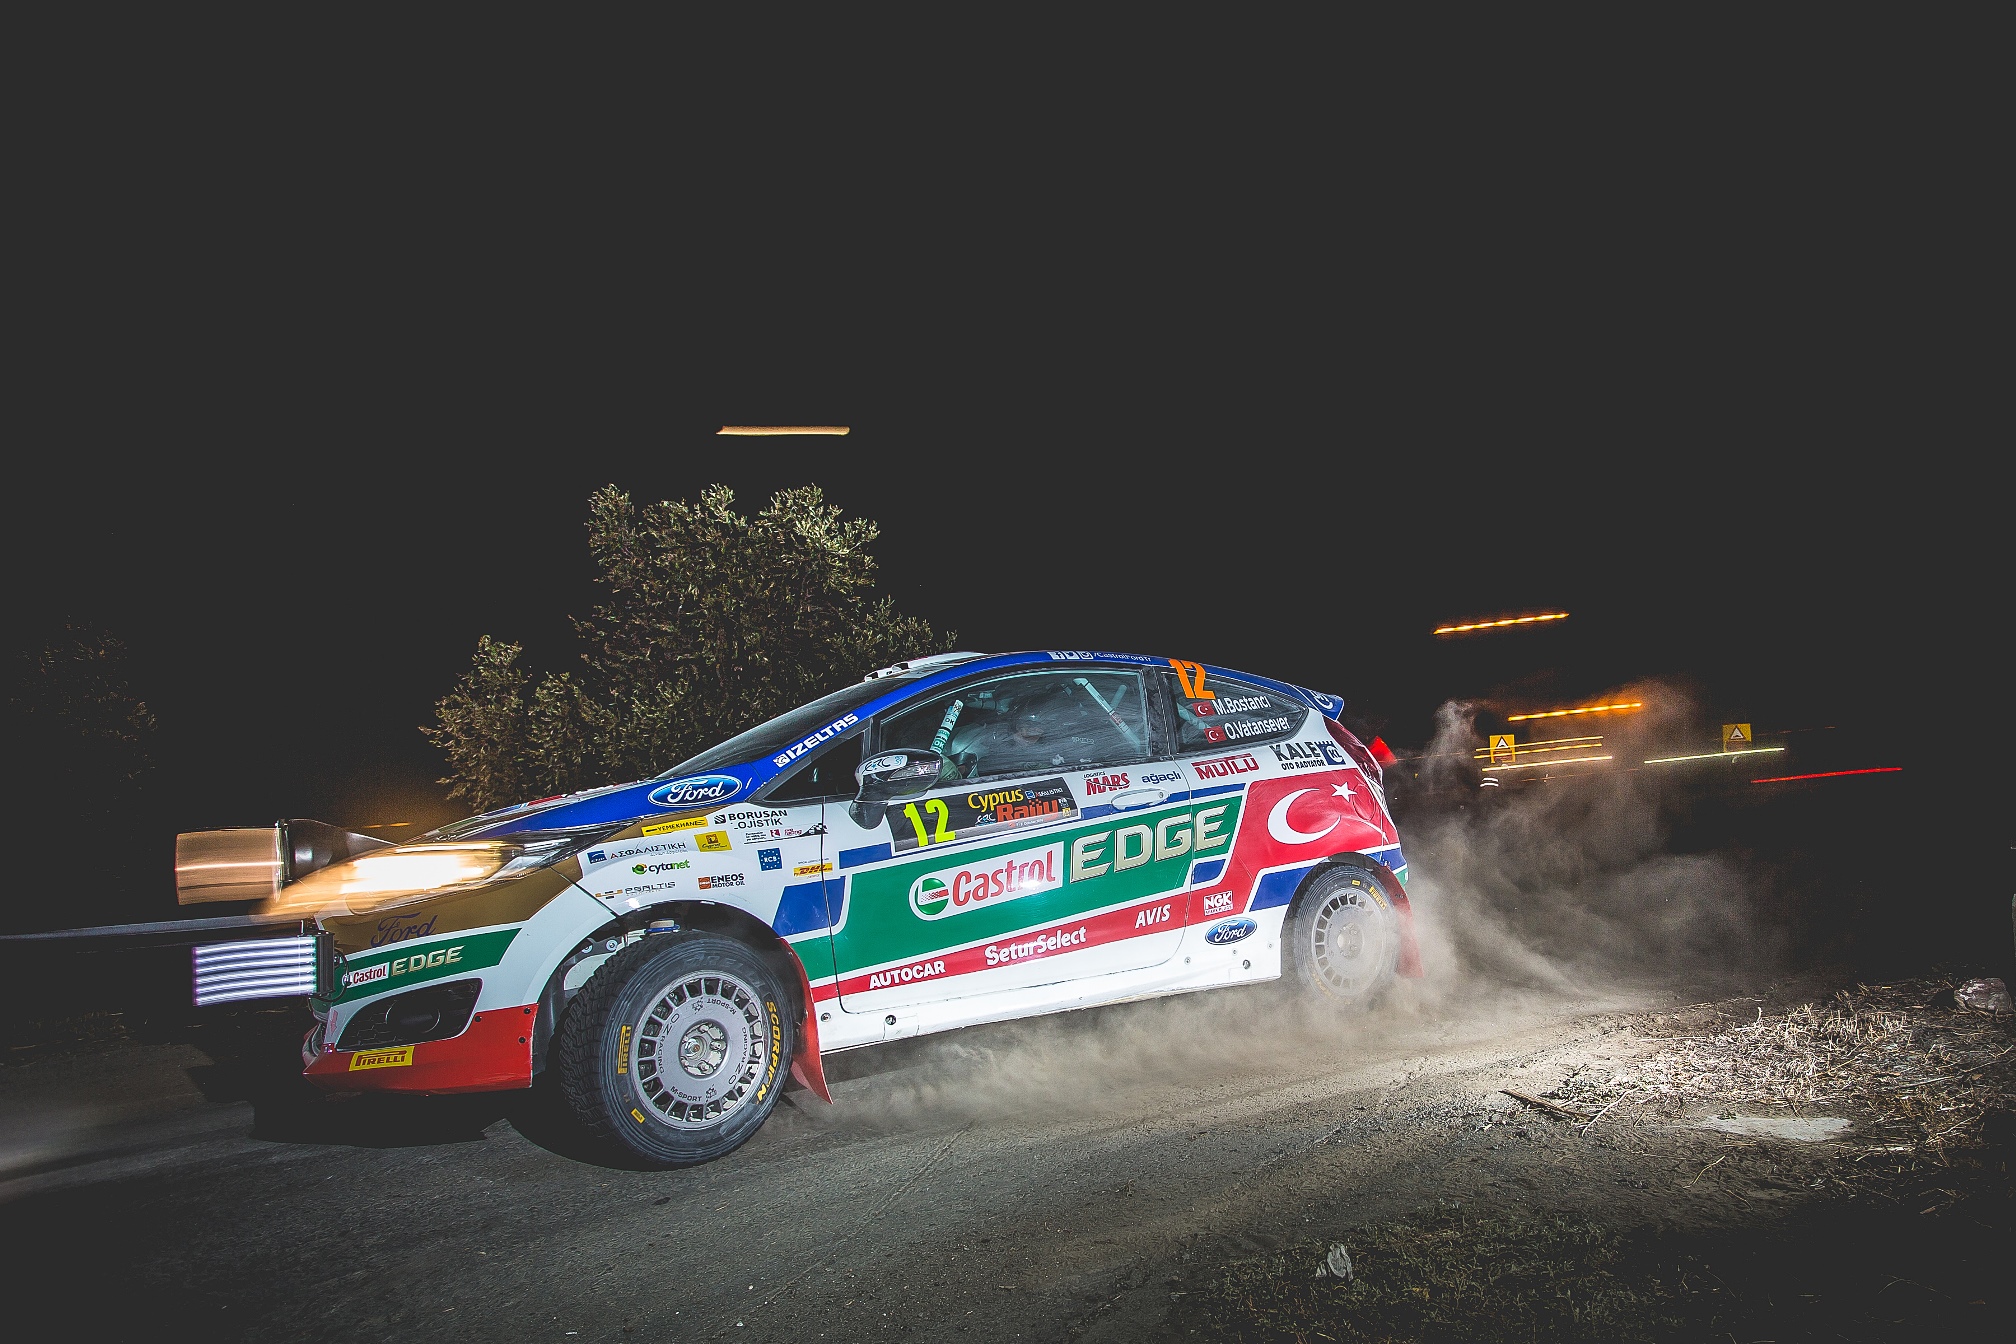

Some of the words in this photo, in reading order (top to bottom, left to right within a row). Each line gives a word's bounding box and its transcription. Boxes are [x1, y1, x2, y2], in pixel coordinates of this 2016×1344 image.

[1169, 658, 1216, 699] 12
[1224, 715, 1290, 740] O.Vatansever
[1269, 741, 1322, 763] KALE
[1141, 770, 1181, 785] ağaçlı
[1191, 753, 1260, 780] MUTLU
[1281, 761, 1295, 771] OTO
[666, 780, 724, 803] Ford
[1086, 772, 1130, 796] MARS
[967, 788, 1024, 813] Cyprus
[728, 809, 788, 822] BORUSAN
[903, 798, 957, 848] 12
[1069, 803, 1233, 883] EDGE
[648, 860, 691, 875] cytanet
[711, 872, 745, 884] ENEOS
[951, 849, 1056, 907] Castrol
[711, 880, 734, 889] MOTOR
[1205, 890, 1233, 909] NGK
[1135, 904, 1171, 930] AVIS
[370, 912, 438, 949] Ford
[1214, 921, 1248, 943] Ford
[985, 926, 1087, 967] SeturSelect
[353, 965, 388, 985] Castrol
[390, 945, 467, 977] EDGE
[869, 960, 946, 990] AUTOCAR
[354, 1050, 408, 1067] PIRELLI
[617, 1025, 632, 1074] PIRELLI
